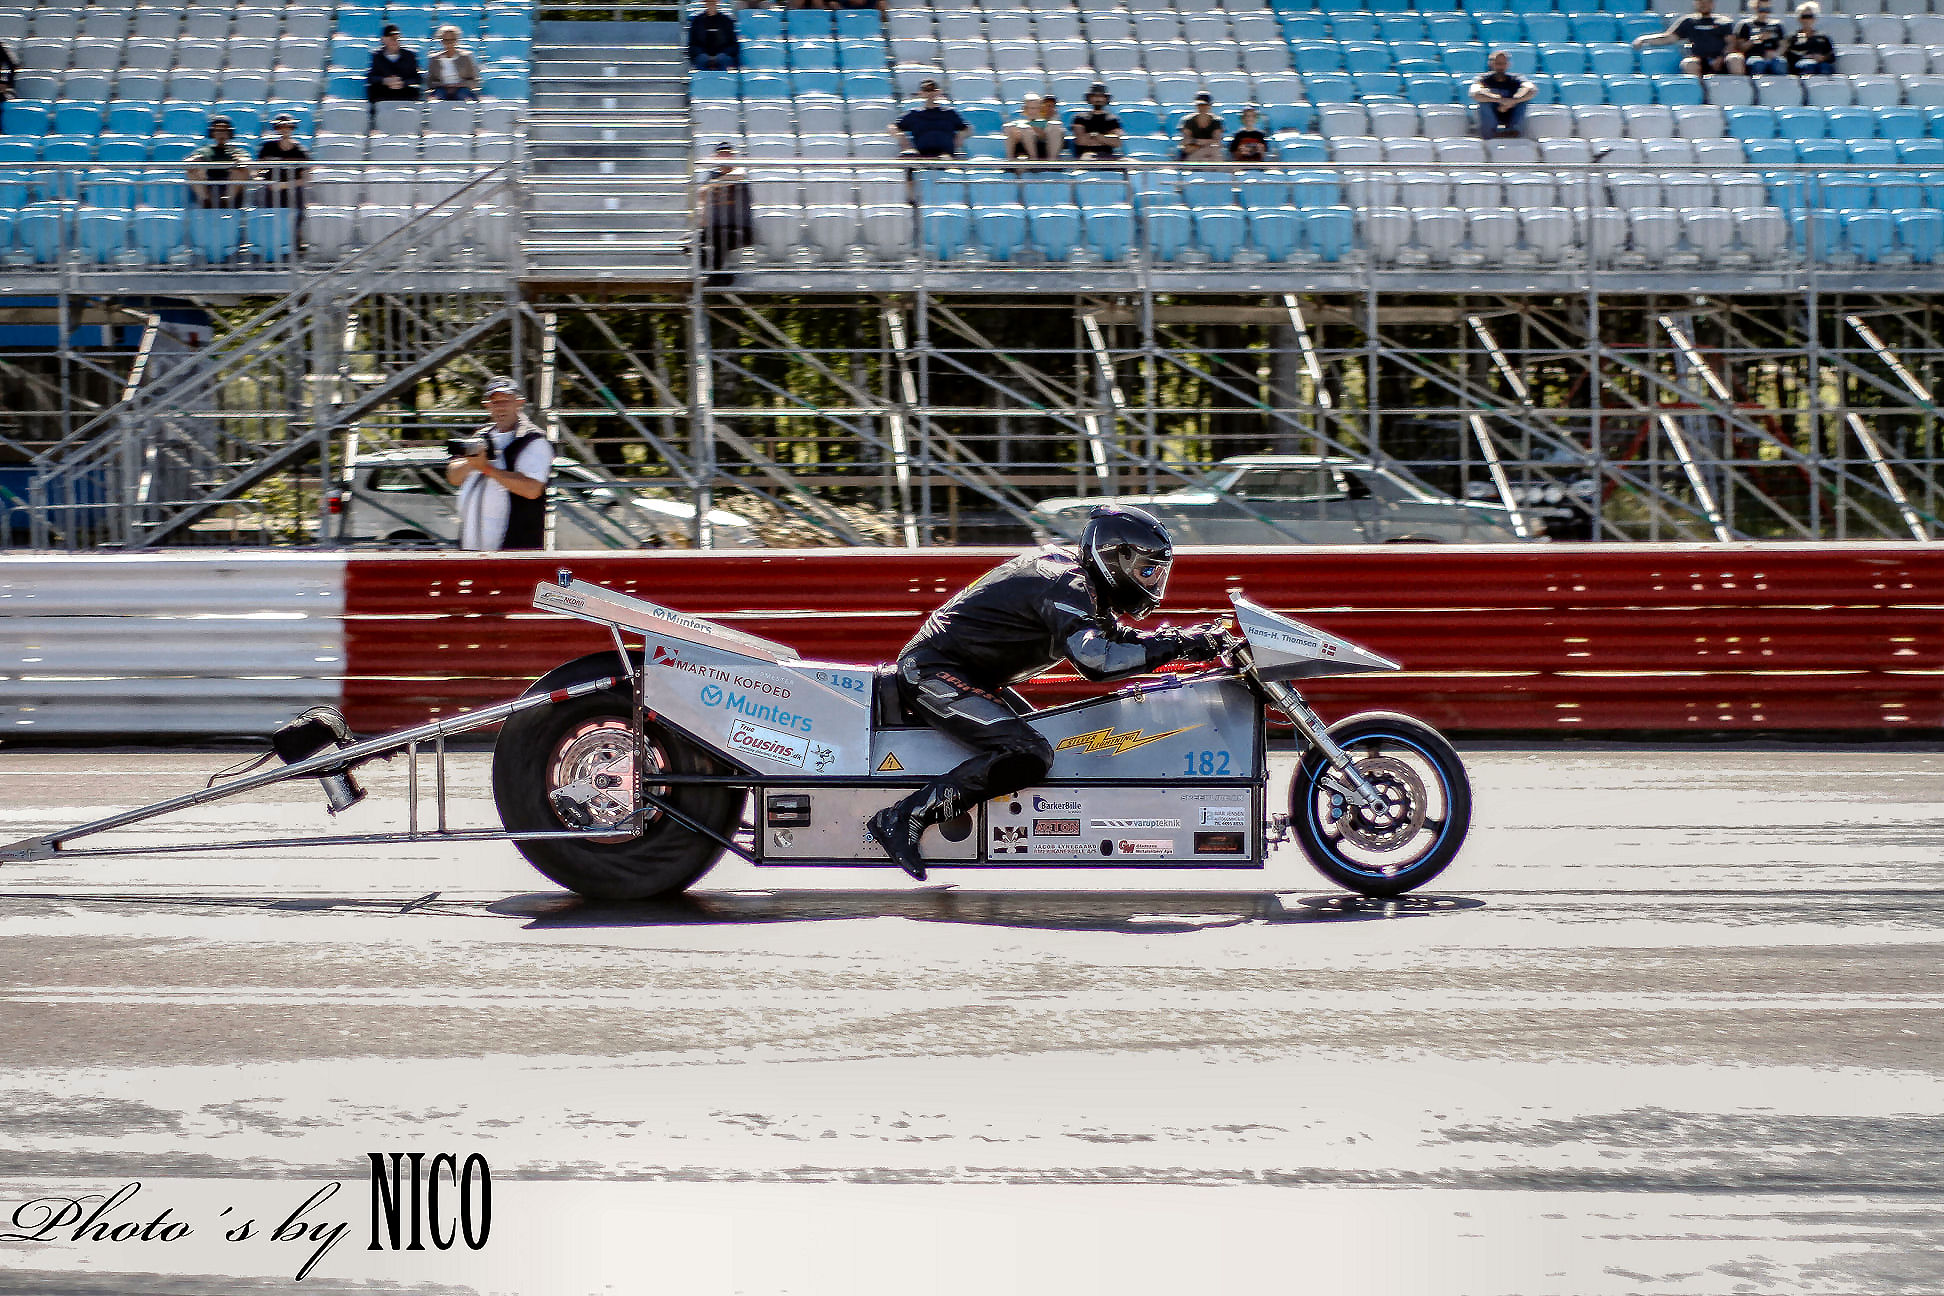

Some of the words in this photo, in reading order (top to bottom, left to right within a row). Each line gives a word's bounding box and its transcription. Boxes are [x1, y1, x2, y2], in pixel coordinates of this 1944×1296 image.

[1282, 634, 1317, 648] Thomsen
[676, 660, 731, 683] MARTIN
[733, 675, 792, 699] KOFOED
[831, 674, 865, 693] 182
[725, 692, 814, 732] Munters
[1183, 751, 1231, 776] 182
[1133, 820, 1181, 829] varupteknik
